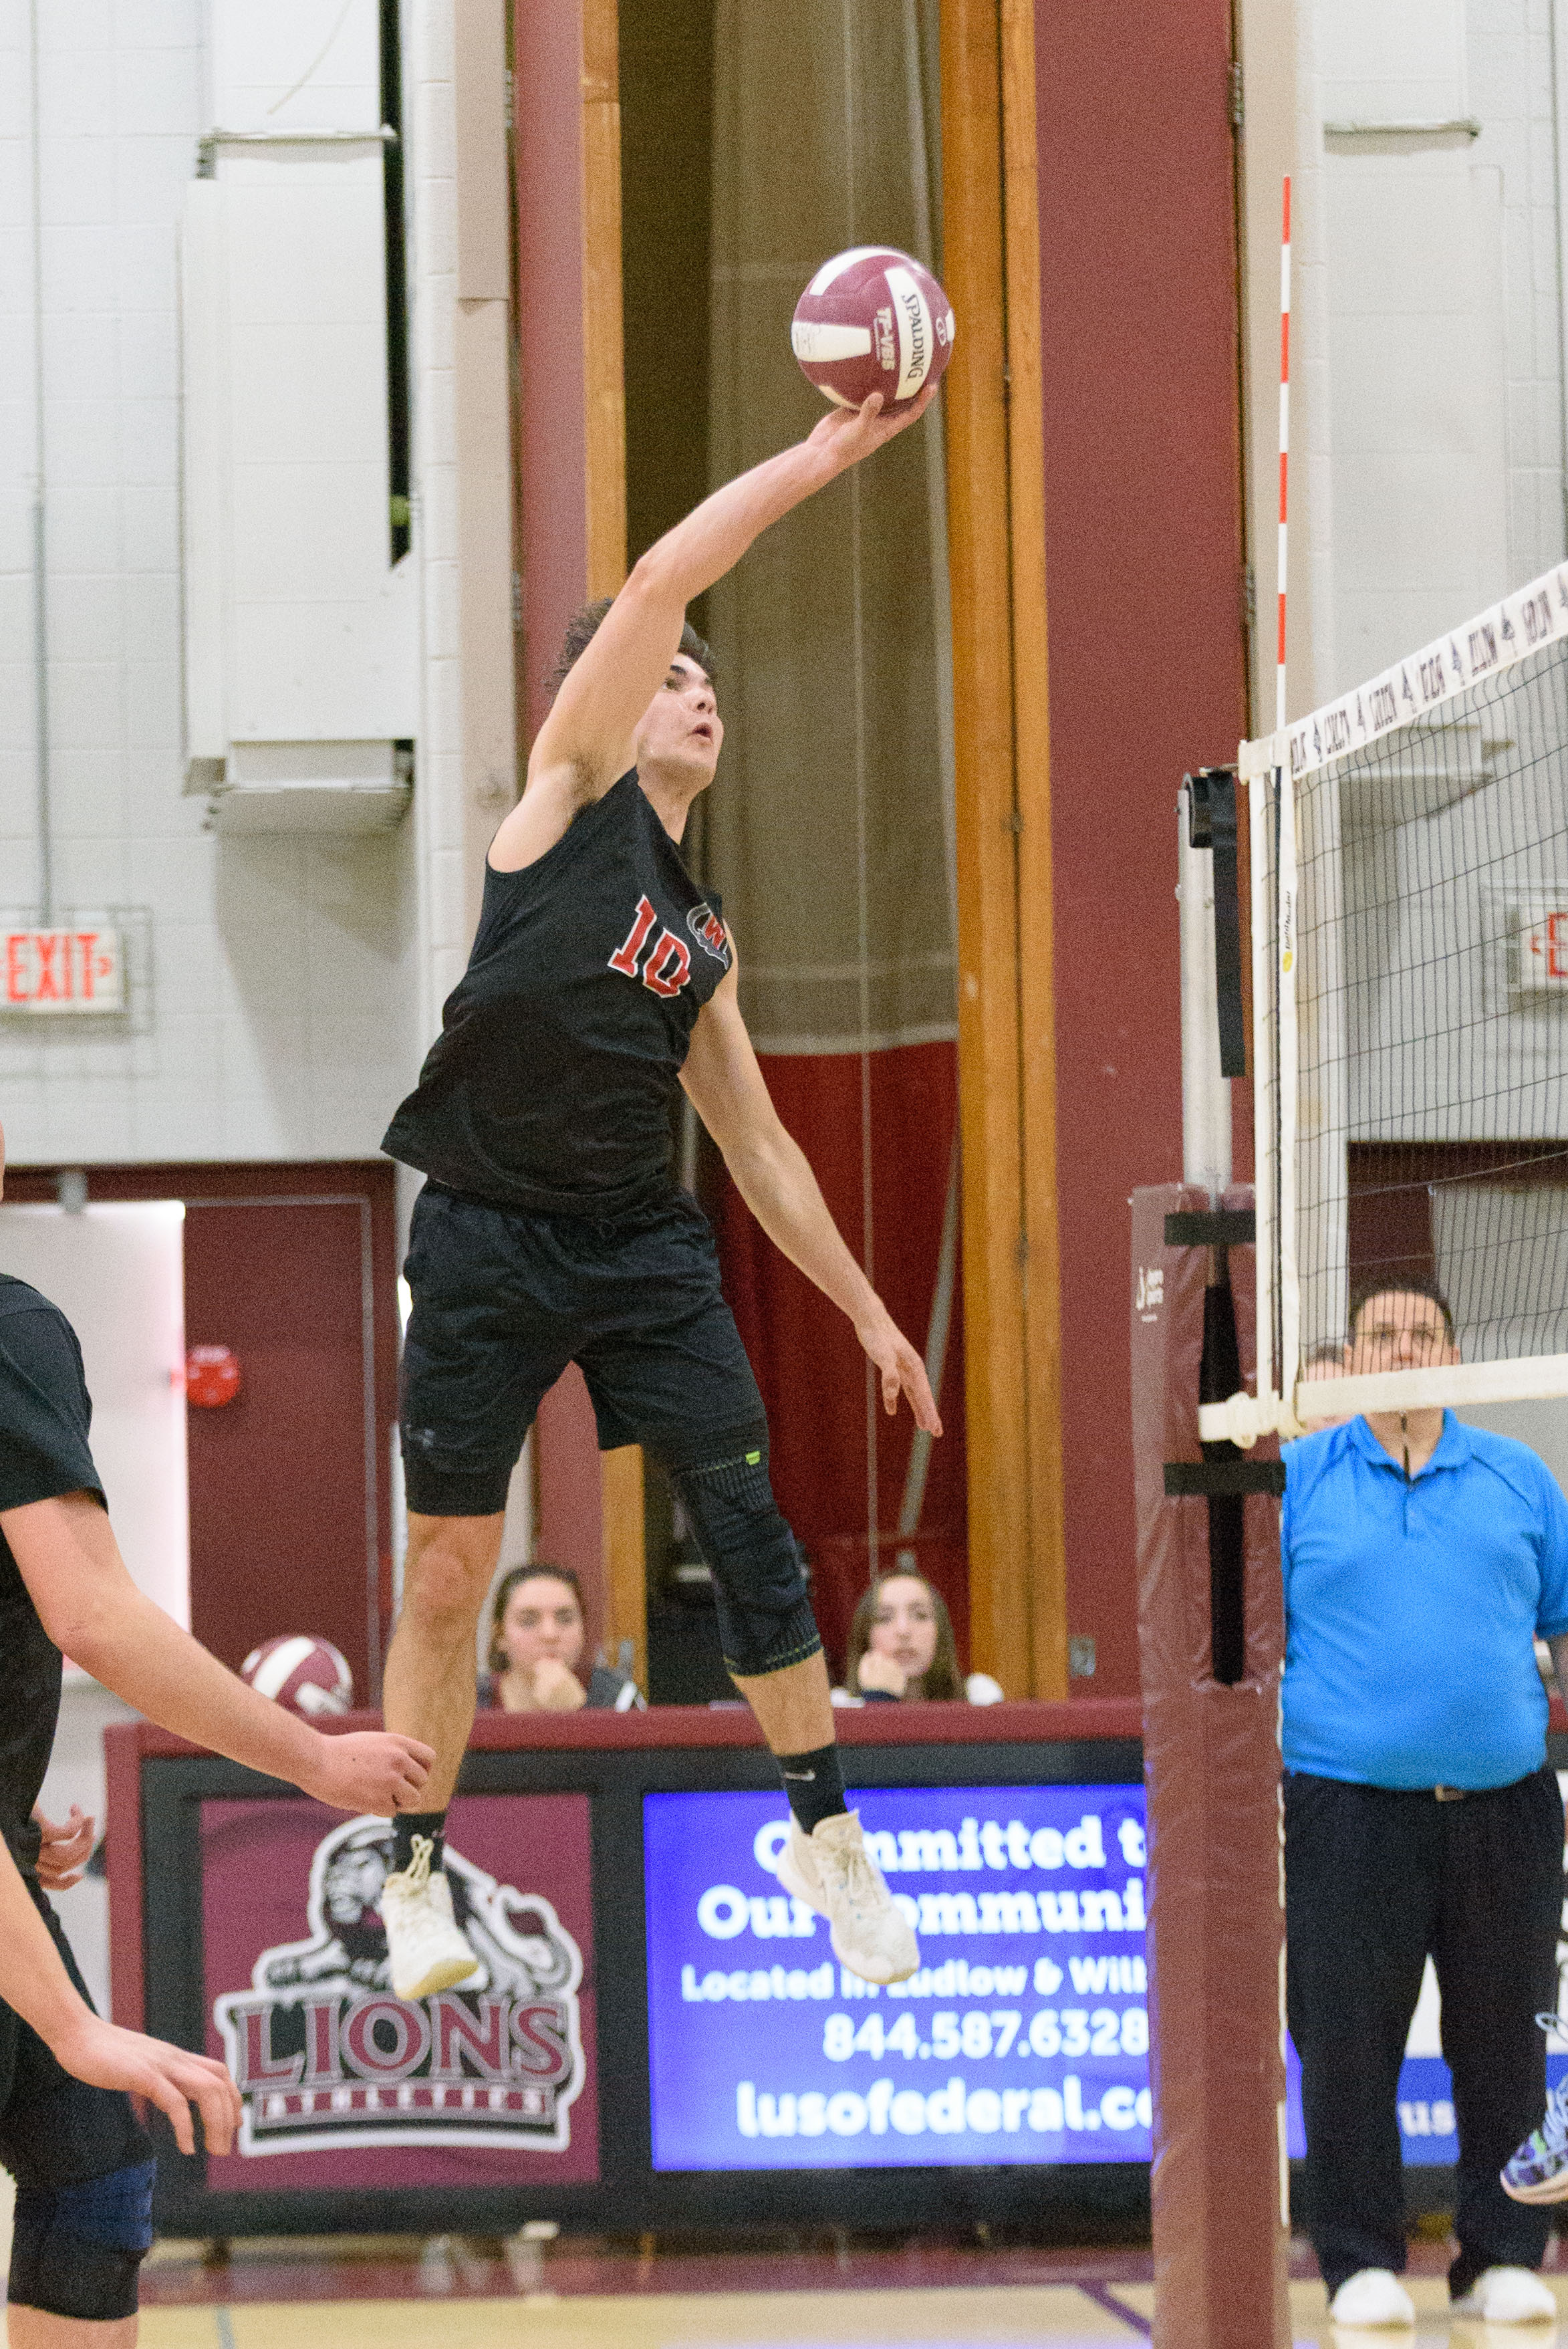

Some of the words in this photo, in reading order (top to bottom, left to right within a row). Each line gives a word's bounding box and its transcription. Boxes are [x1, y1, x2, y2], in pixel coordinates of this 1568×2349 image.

[902, 293, 924, 382] SPALDING
[7, 933, 98, 1003] EXIT
[607, 894, 691, 999] 10
[753, 1814, 1107, 1874] Cmmitted
[696, 1884, 817, 1939] Our
[890, 1877, 1146, 1936] mmuni
[681, 1961, 835, 2002] Located
[233, 1995, 575, 2089] LIONS
[822, 2007, 1150, 2062] 844.587.6328
